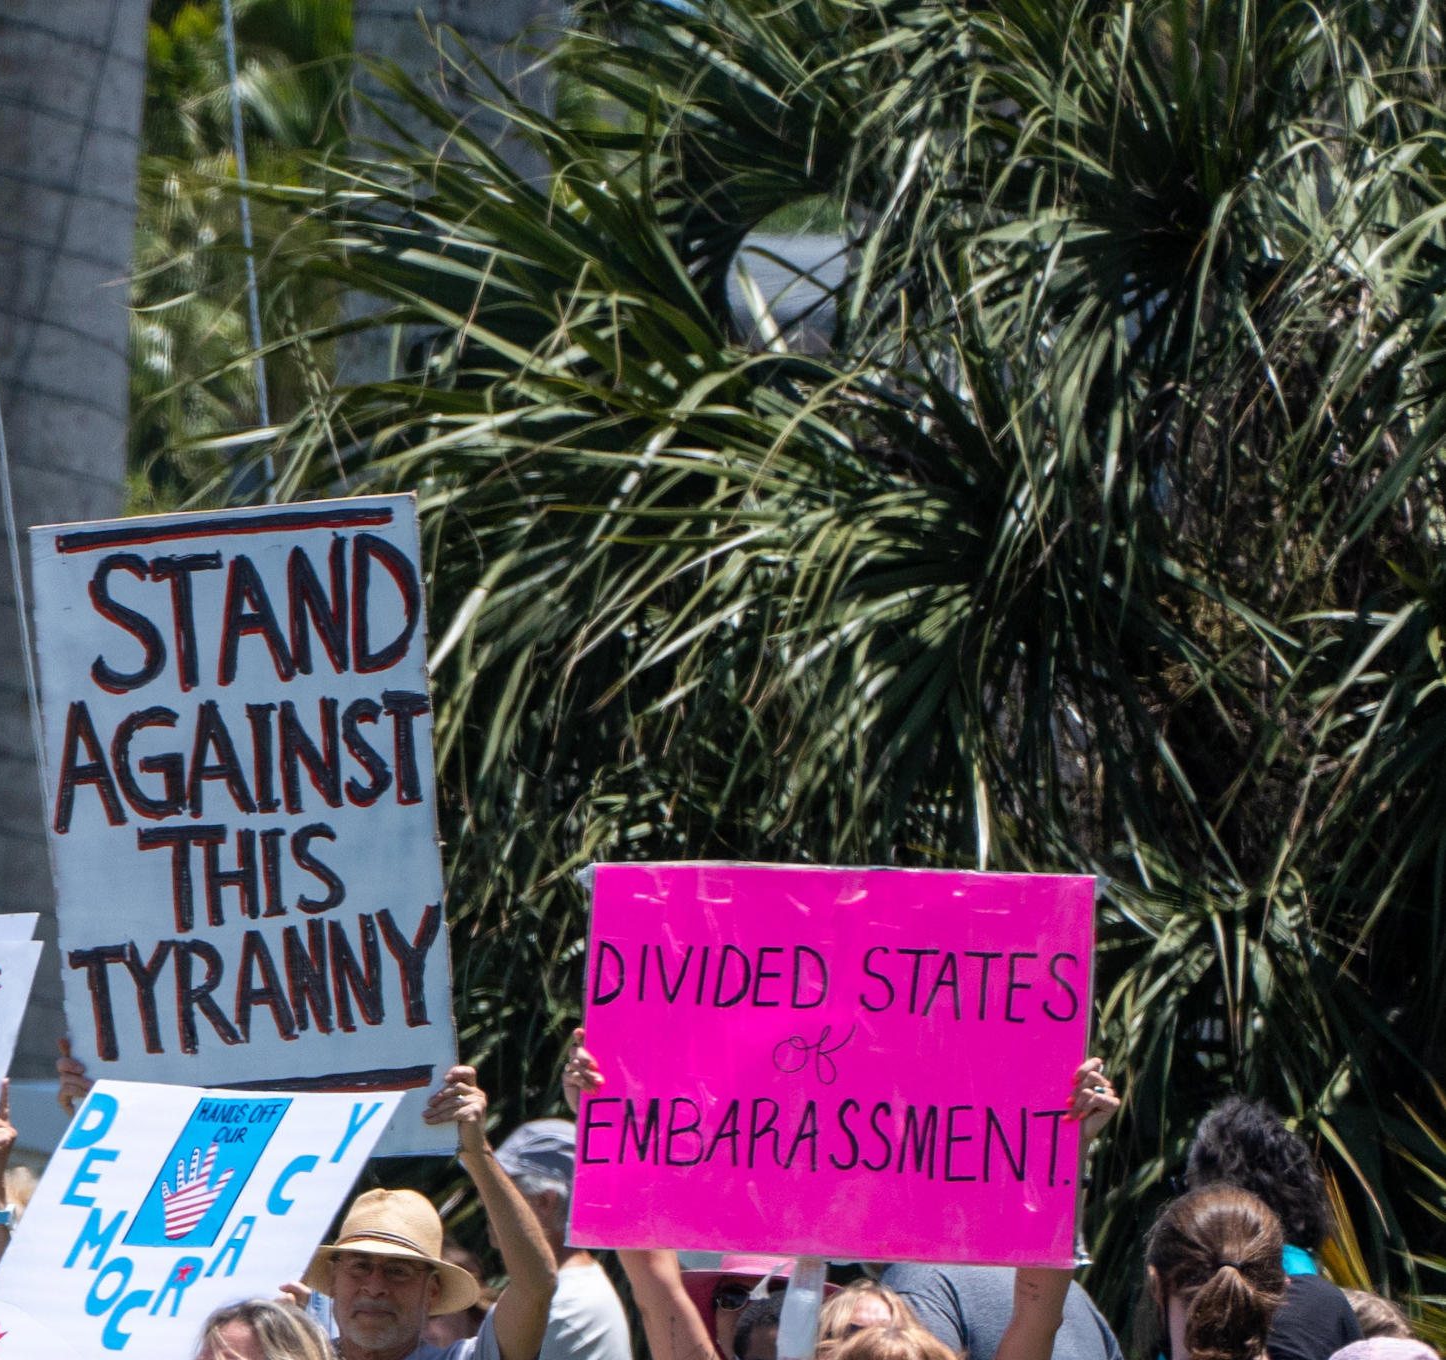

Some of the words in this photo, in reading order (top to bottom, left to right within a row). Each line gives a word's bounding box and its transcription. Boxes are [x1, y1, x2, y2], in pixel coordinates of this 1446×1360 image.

[88, 531, 422, 695] STAND
[54, 688, 432, 835] AGAINST
[137, 822, 347, 932] THIS
[68, 904, 442, 1062] TYRANNY
[591, 940, 830, 1009] DIVIDED
[858, 945, 1079, 1024] STATES
[772, 1023, 857, 1085] of
[196, 1102, 245, 1124] HANDS
[248, 1102, 283, 1123] OFF
[212, 1125, 251, 1144] OUR
[582, 1097, 1072, 1187] EMBARASSMENT.
